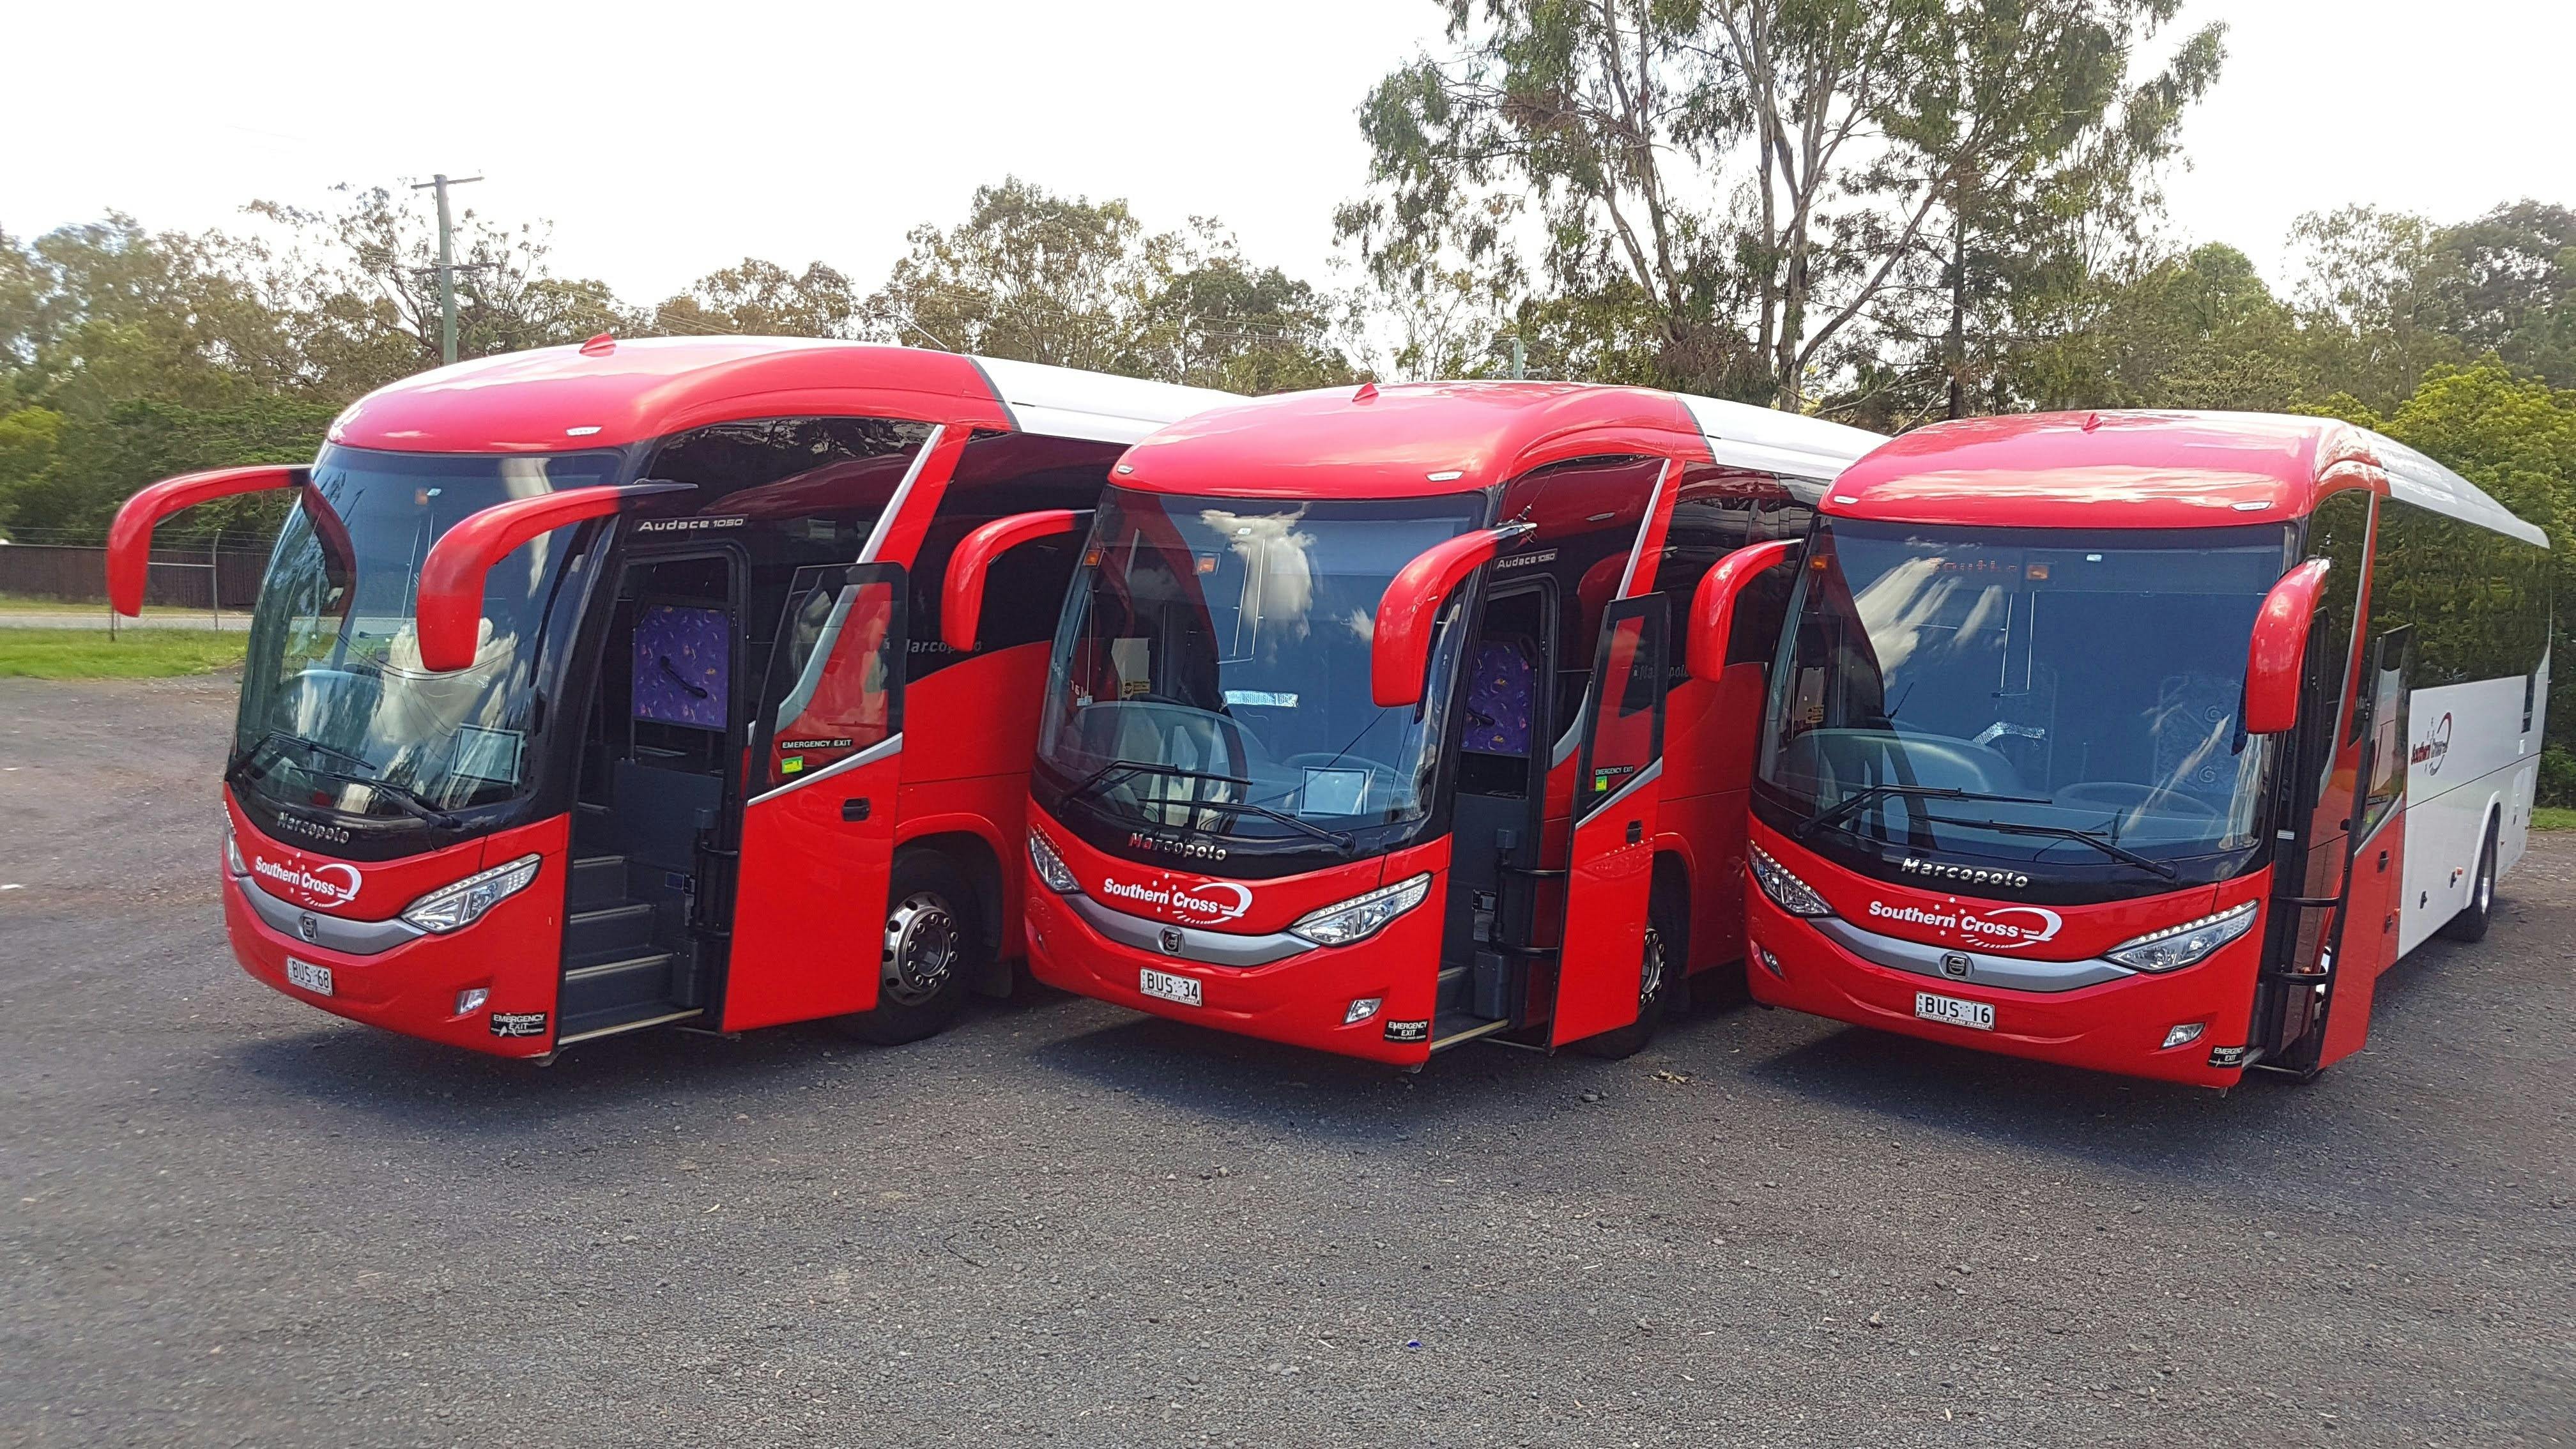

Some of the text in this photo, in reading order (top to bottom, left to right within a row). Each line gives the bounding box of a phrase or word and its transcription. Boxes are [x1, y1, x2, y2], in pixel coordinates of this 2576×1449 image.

[638, 518, 744, 532] Audace 1050
[1496, 556, 1537, 569] Audace
[782, 740, 831, 749] EMERGENCY
[277, 811, 349, 844] Marcopolo
[1128, 832, 1227, 861] Marcopolo
[256, 855, 335, 896] Southern Cross
[1901, 858, 2028, 888] Marcopolo
[1104, 878, 1218, 914] Southern Cross
[1869, 901, 2018, 937] Southern Cross
[291, 960, 312, 983] BUS
[317, 969, 329, 988] 68
[1147, 972, 1198, 999] BUS 34
[493, 1014, 544, 1023] EMERGENCY
[1925, 997, 1991, 1023] BUS 16
[1388, 1021, 1428, 1029] EMERGENCY
